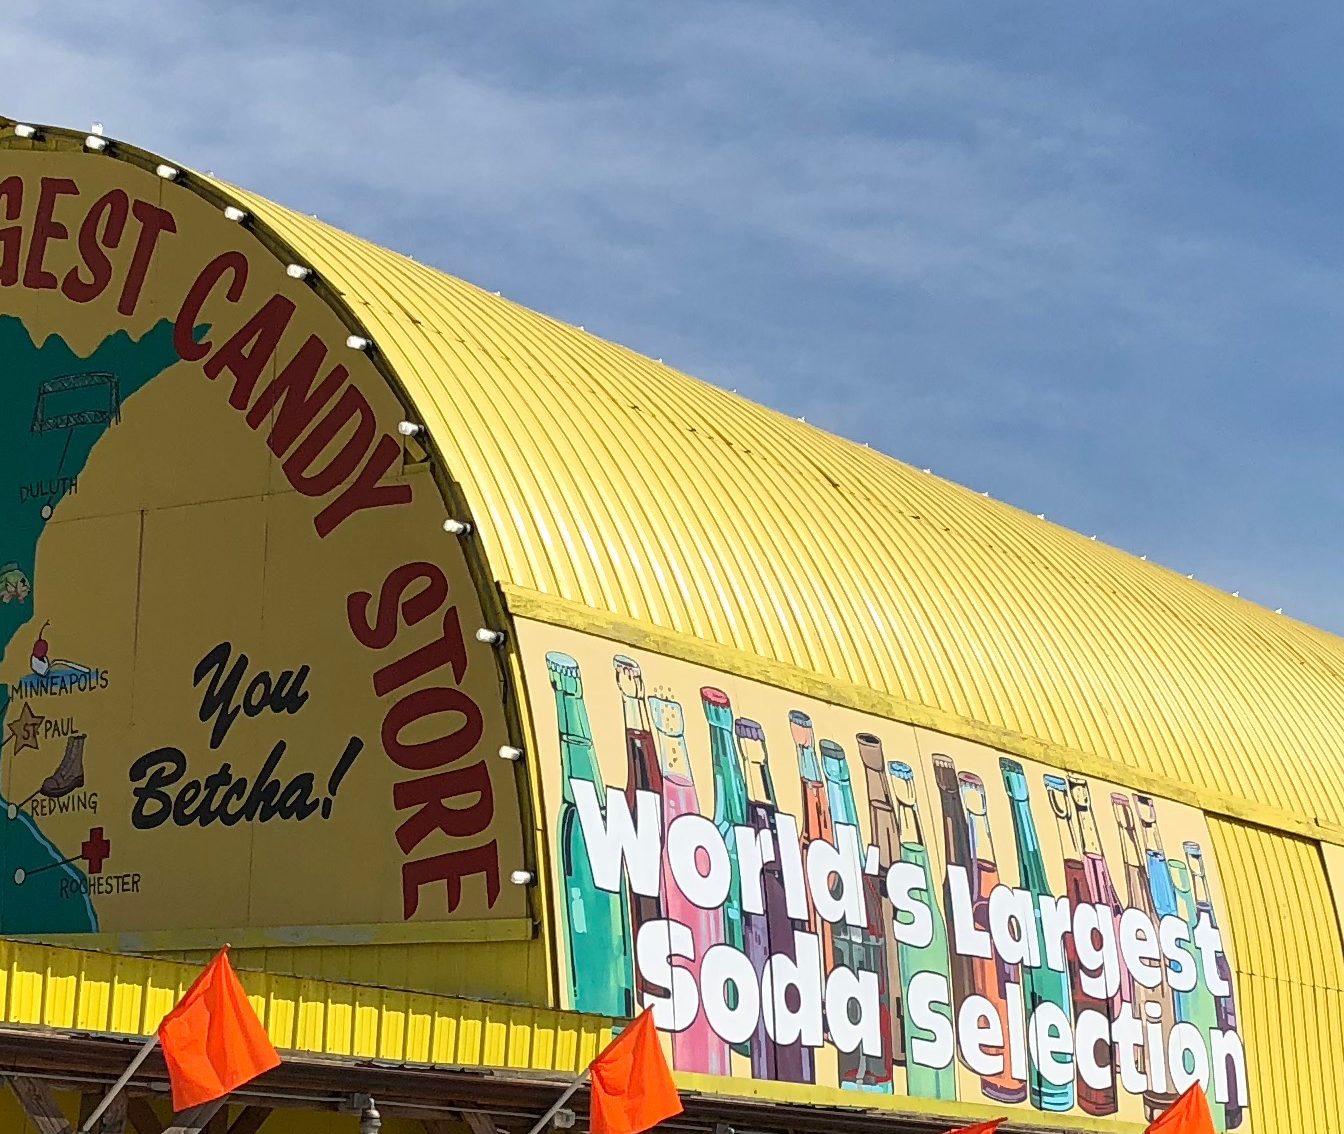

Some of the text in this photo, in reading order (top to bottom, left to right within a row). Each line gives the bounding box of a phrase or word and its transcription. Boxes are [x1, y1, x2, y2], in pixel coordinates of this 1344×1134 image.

[19, 475, 78, 503] DULUTH
[173, 251, 413, 539] CANDY
[347, 562, 501, 920] STORE
[10, 670, 109, 702] MINNEAPOLIS
[44, 716, 79, 739] PAUL
[193, 641, 310, 750] You
[129, 735, 364, 829] Betcha!
[60, 873, 141, 899] ROCHESTER
[570, 777, 1232, 1000] World's Largest
[636, 919, 883, 1057] Soda
